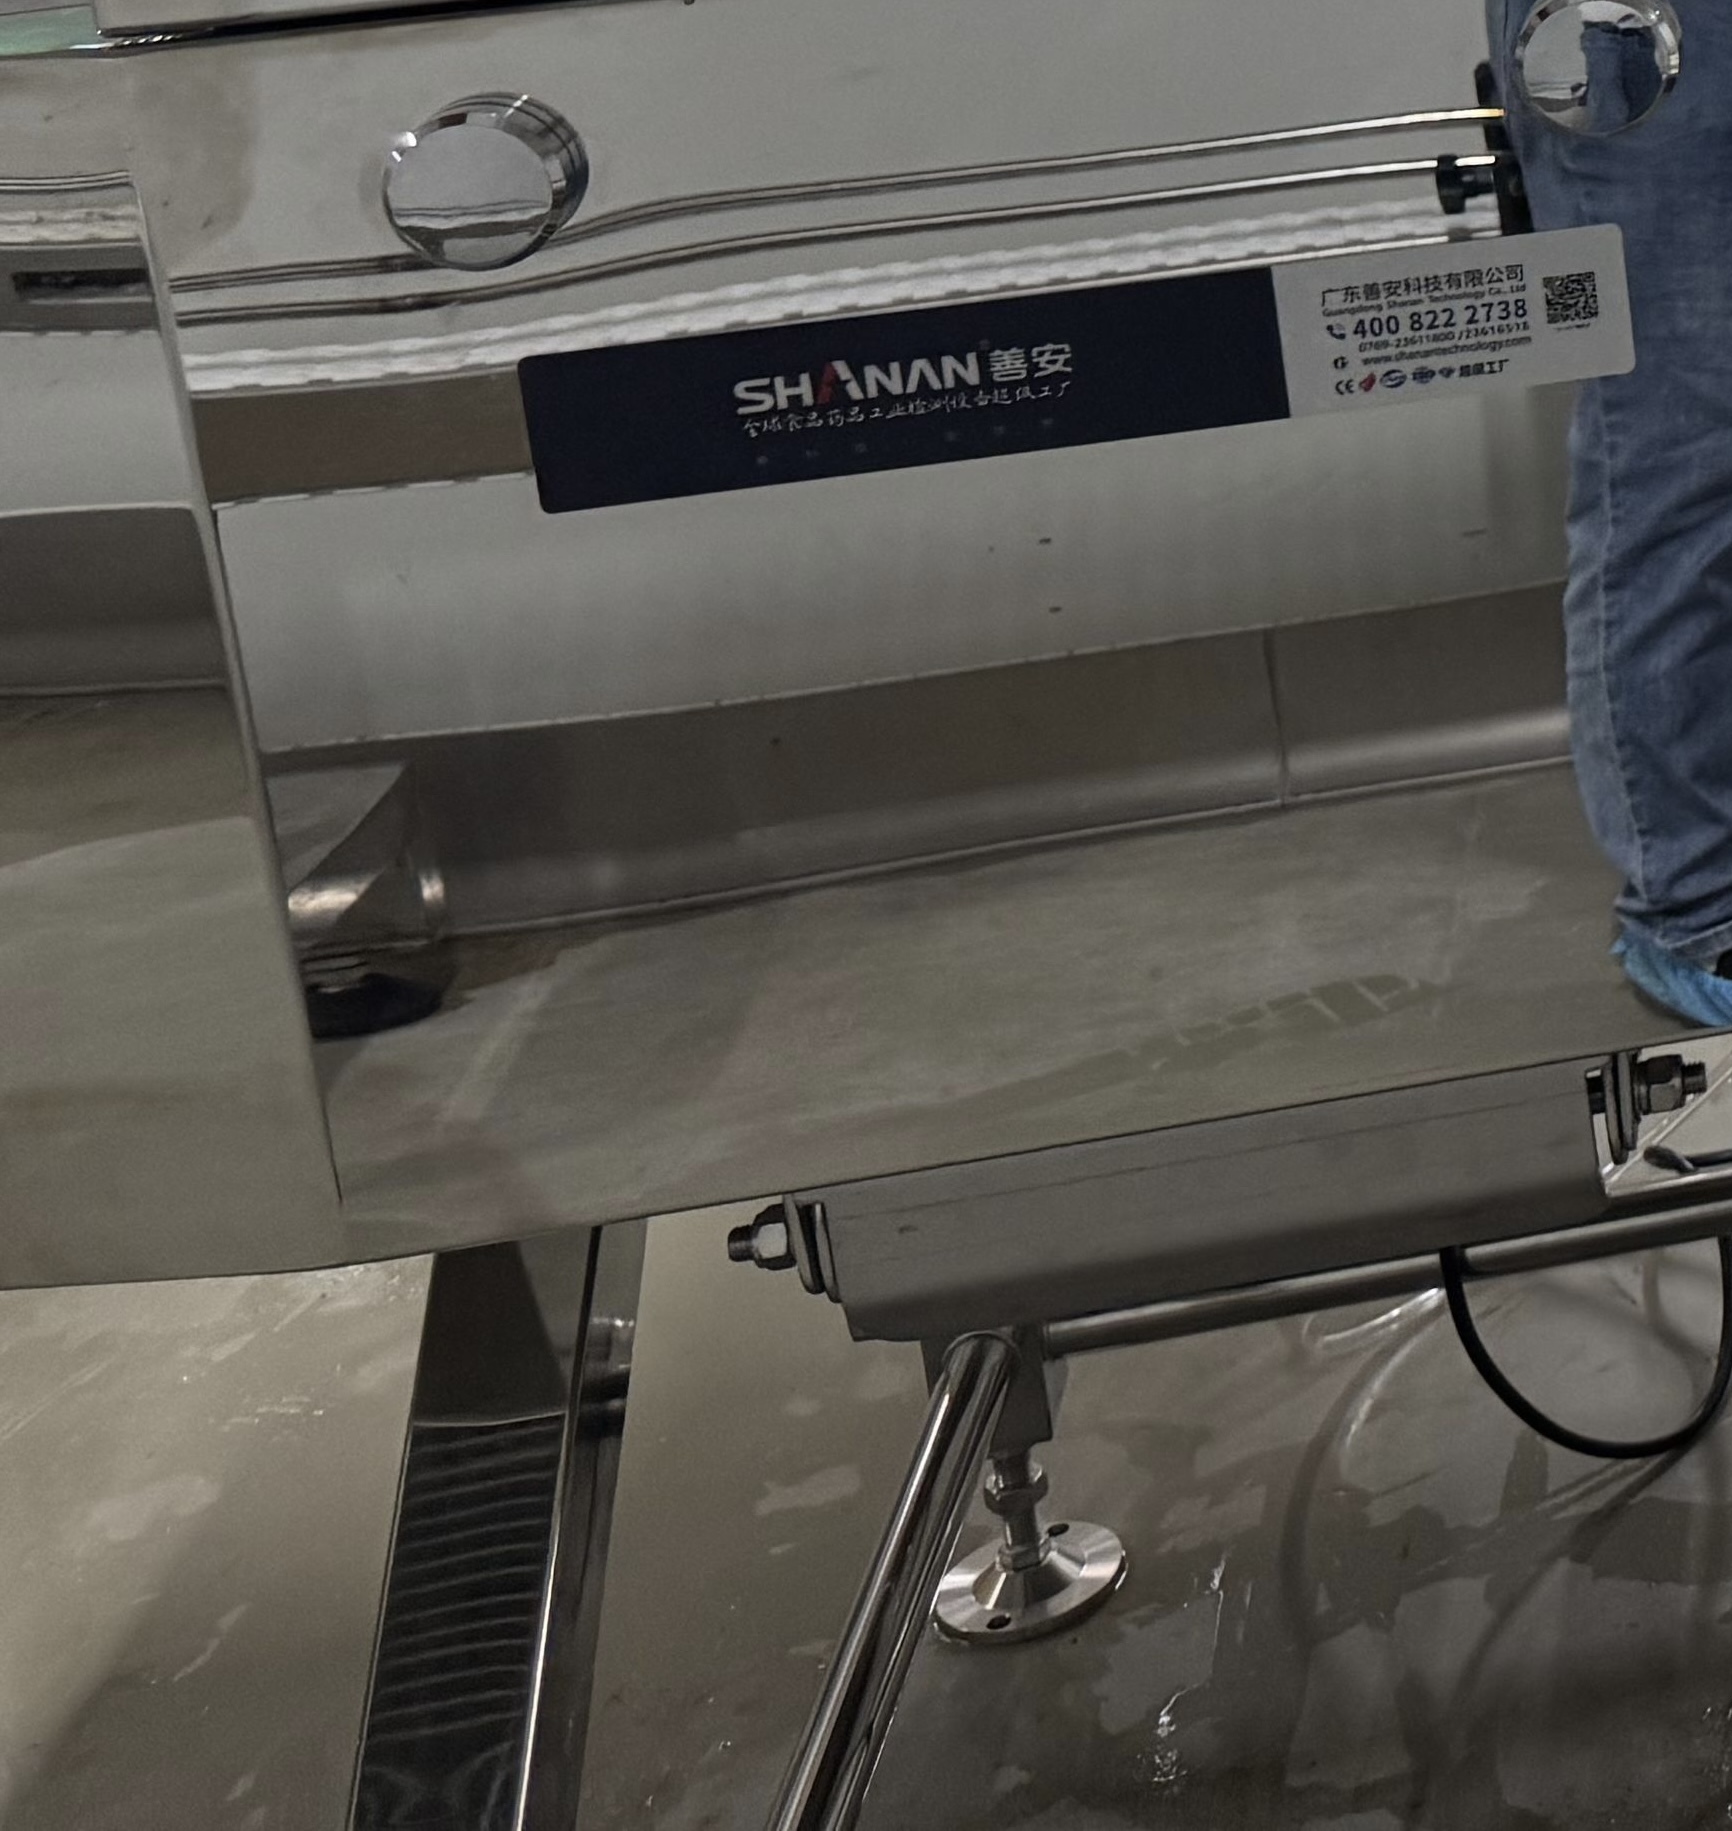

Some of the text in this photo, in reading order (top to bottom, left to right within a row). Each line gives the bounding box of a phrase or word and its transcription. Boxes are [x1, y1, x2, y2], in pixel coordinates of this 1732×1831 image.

[1321, 264, 1525, 307] 广东善安科技有限公司
[1353, 298, 1528, 339] 400 822 2738
[734, 343, 1074, 416] SHANAN 善安
